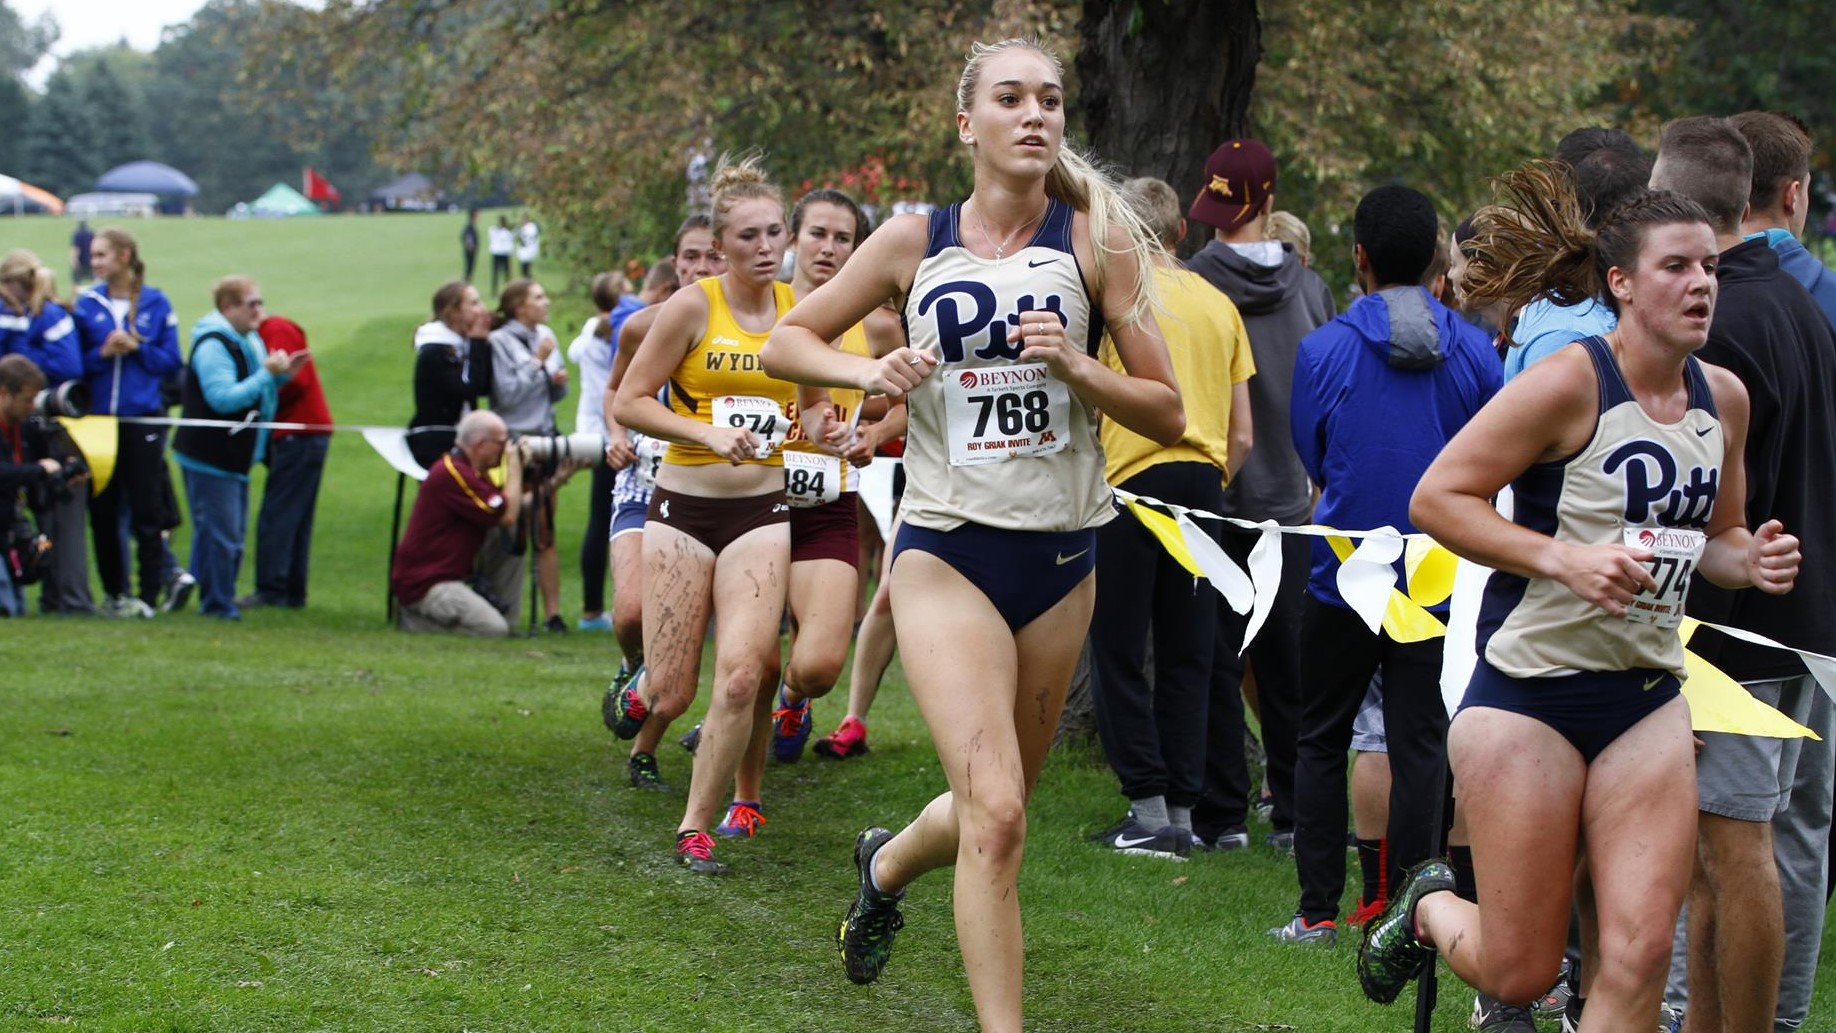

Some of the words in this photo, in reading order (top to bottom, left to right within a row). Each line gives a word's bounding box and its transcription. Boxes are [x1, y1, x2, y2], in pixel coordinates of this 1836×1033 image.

[980, 367, 1047, 386] BEYNON
[967, 390, 1050, 438] 768
[967, 441, 982, 451] ROY
[984, 441, 1006, 450] GRIAK
[1007, 438, 1031, 448] INVITE
[785, 453, 828, 466] BEYNON
[1602, 440, 1718, 526] Pitt
[1656, 532, 1696, 549] BEYNON
